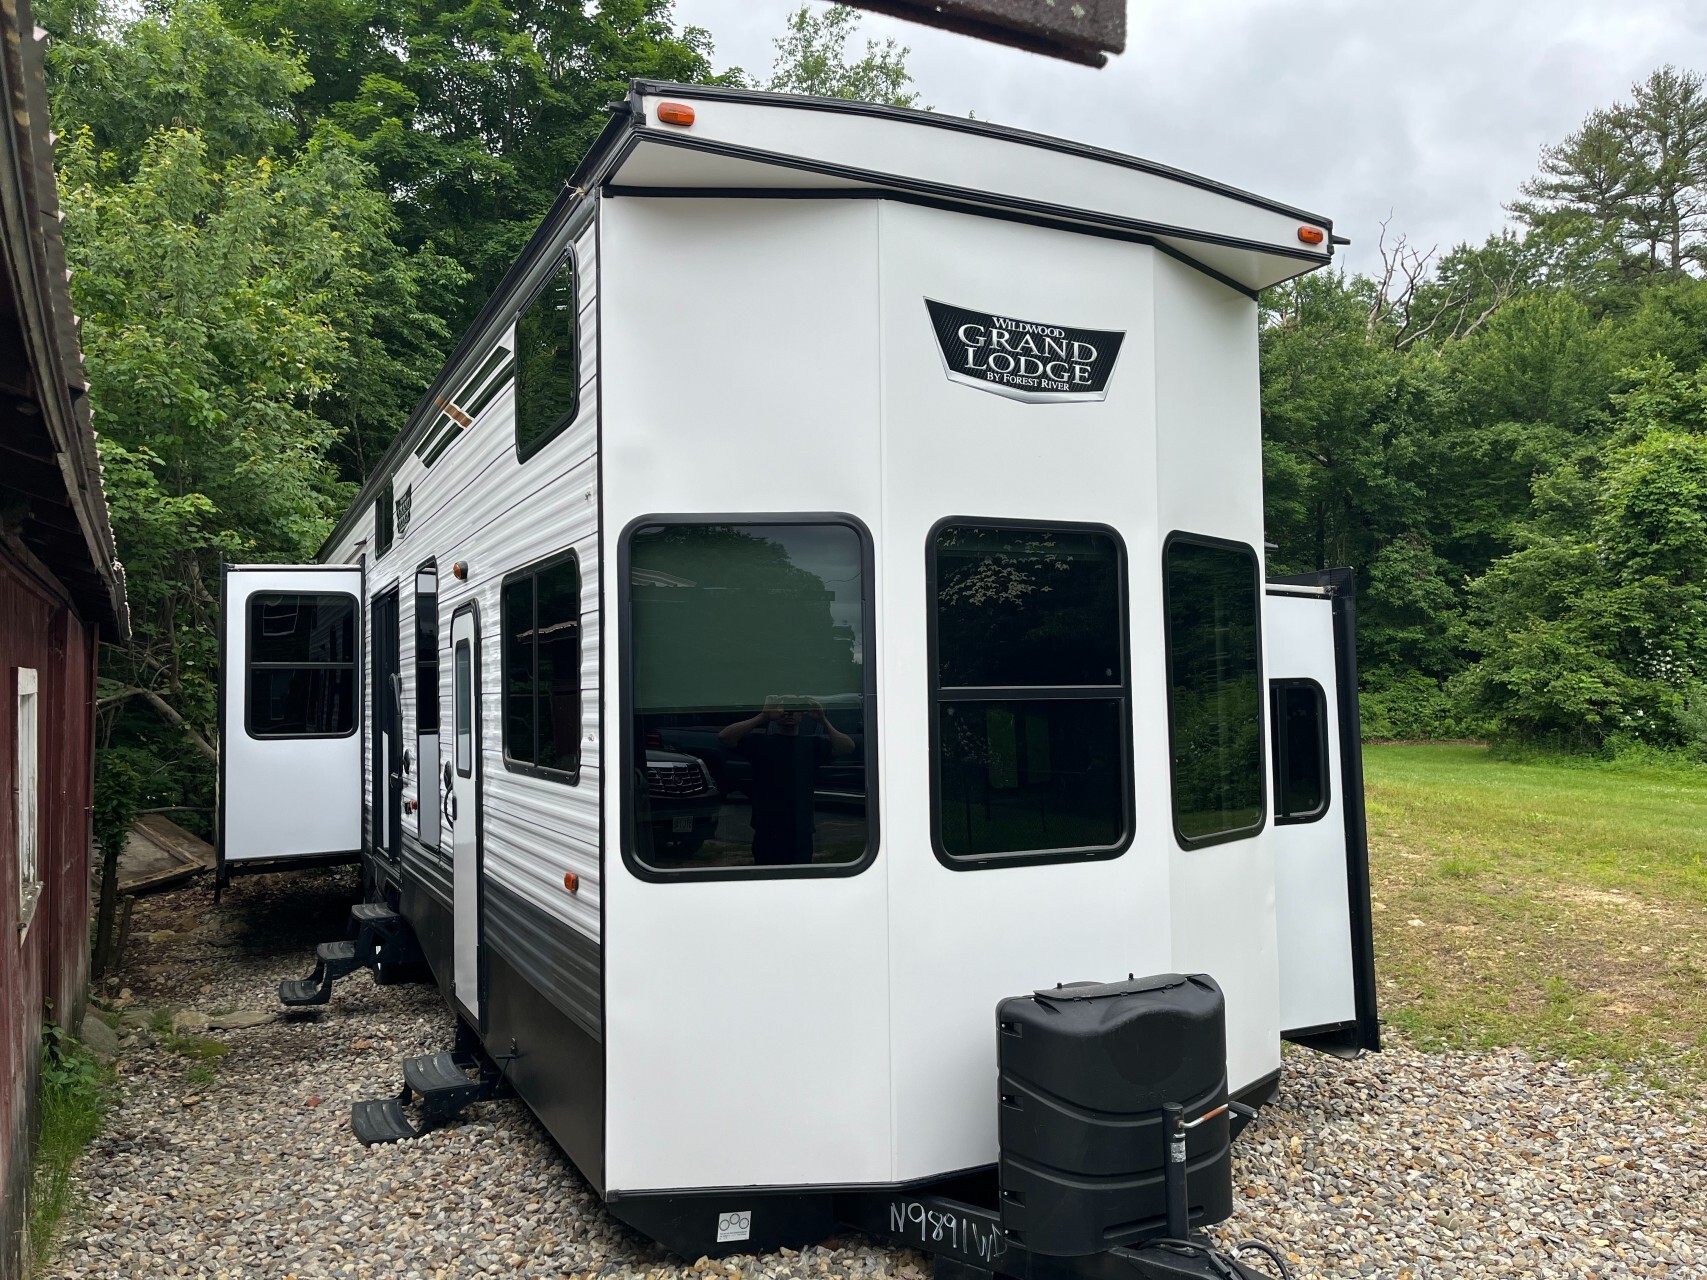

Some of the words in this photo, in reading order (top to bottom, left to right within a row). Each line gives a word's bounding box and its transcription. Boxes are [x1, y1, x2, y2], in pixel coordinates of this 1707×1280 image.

[992, 317, 1065, 338] WILDWOOD
[958, 324, 1098, 363] GRAND
[964, 346, 1092, 385] LODGE
[986, 371, 1001, 382] BY
[1003, 373, 1039, 387] FOREST
[1041, 379, 1070, 391] RIVER
